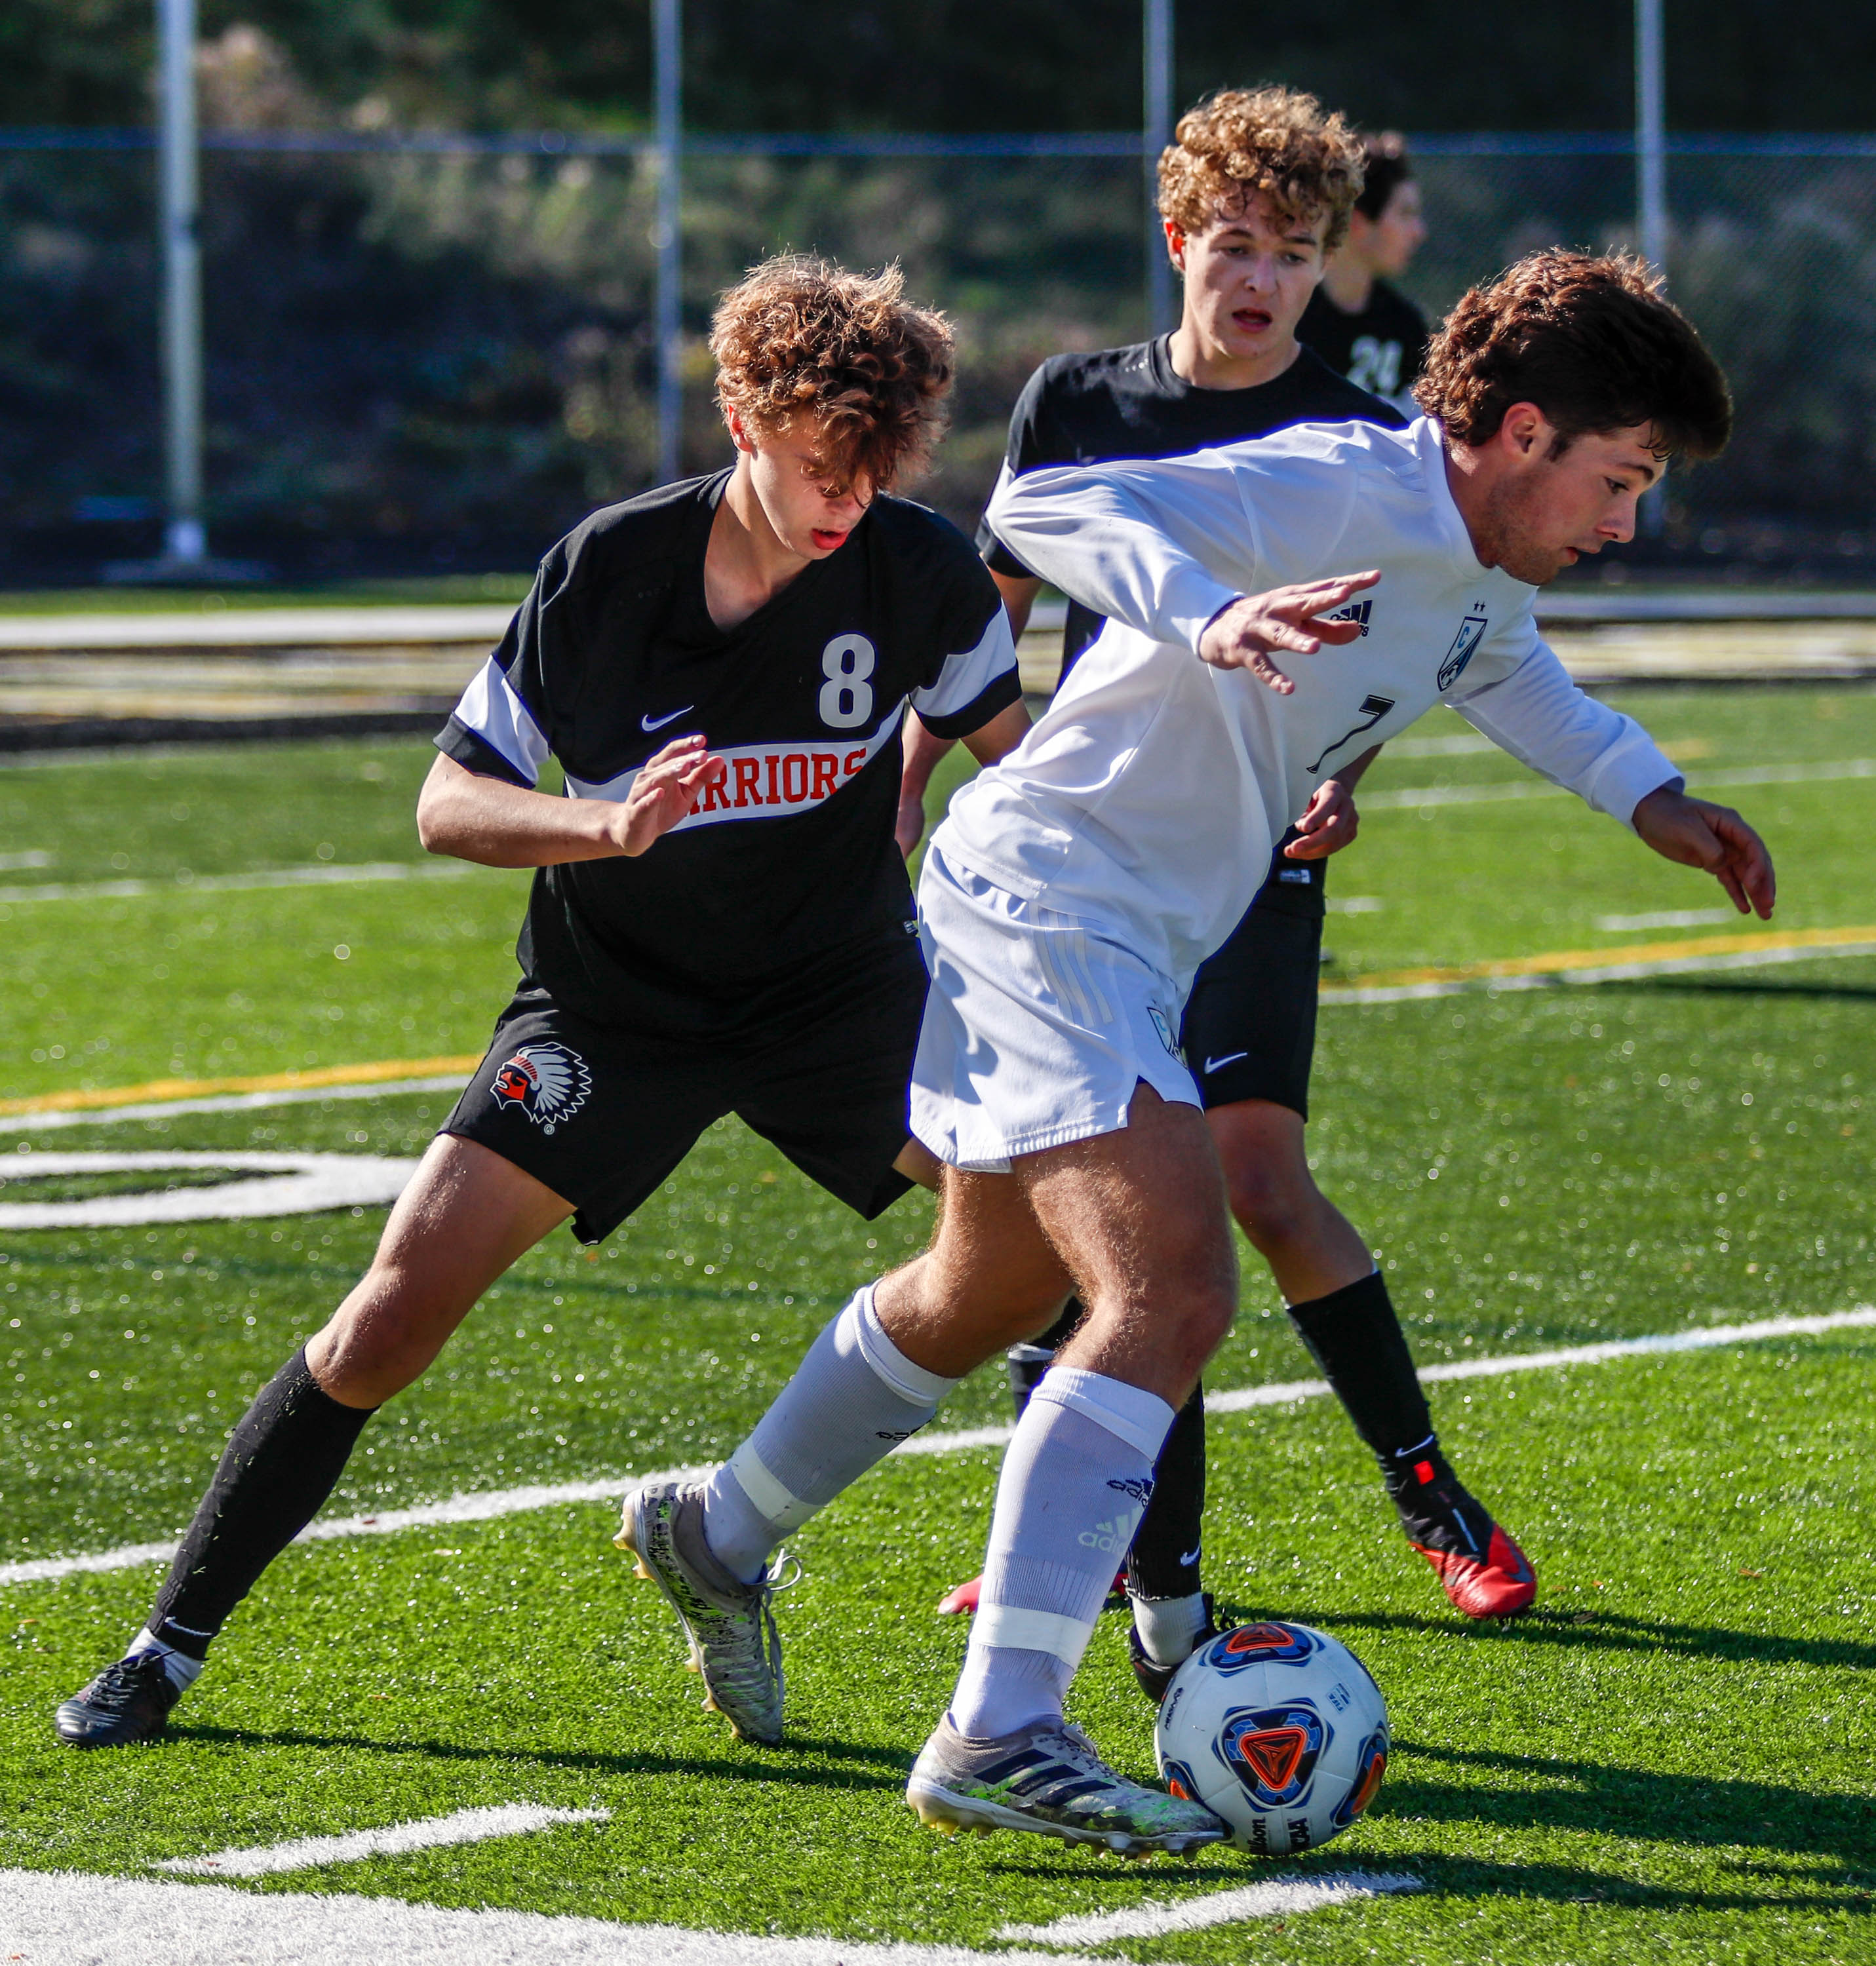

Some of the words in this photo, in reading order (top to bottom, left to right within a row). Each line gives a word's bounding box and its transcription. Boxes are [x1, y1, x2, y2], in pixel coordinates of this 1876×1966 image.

[819, 633, 876, 728] 8
[1306, 694, 1396, 774] 7
[690, 747, 867, 816] RRIORS
